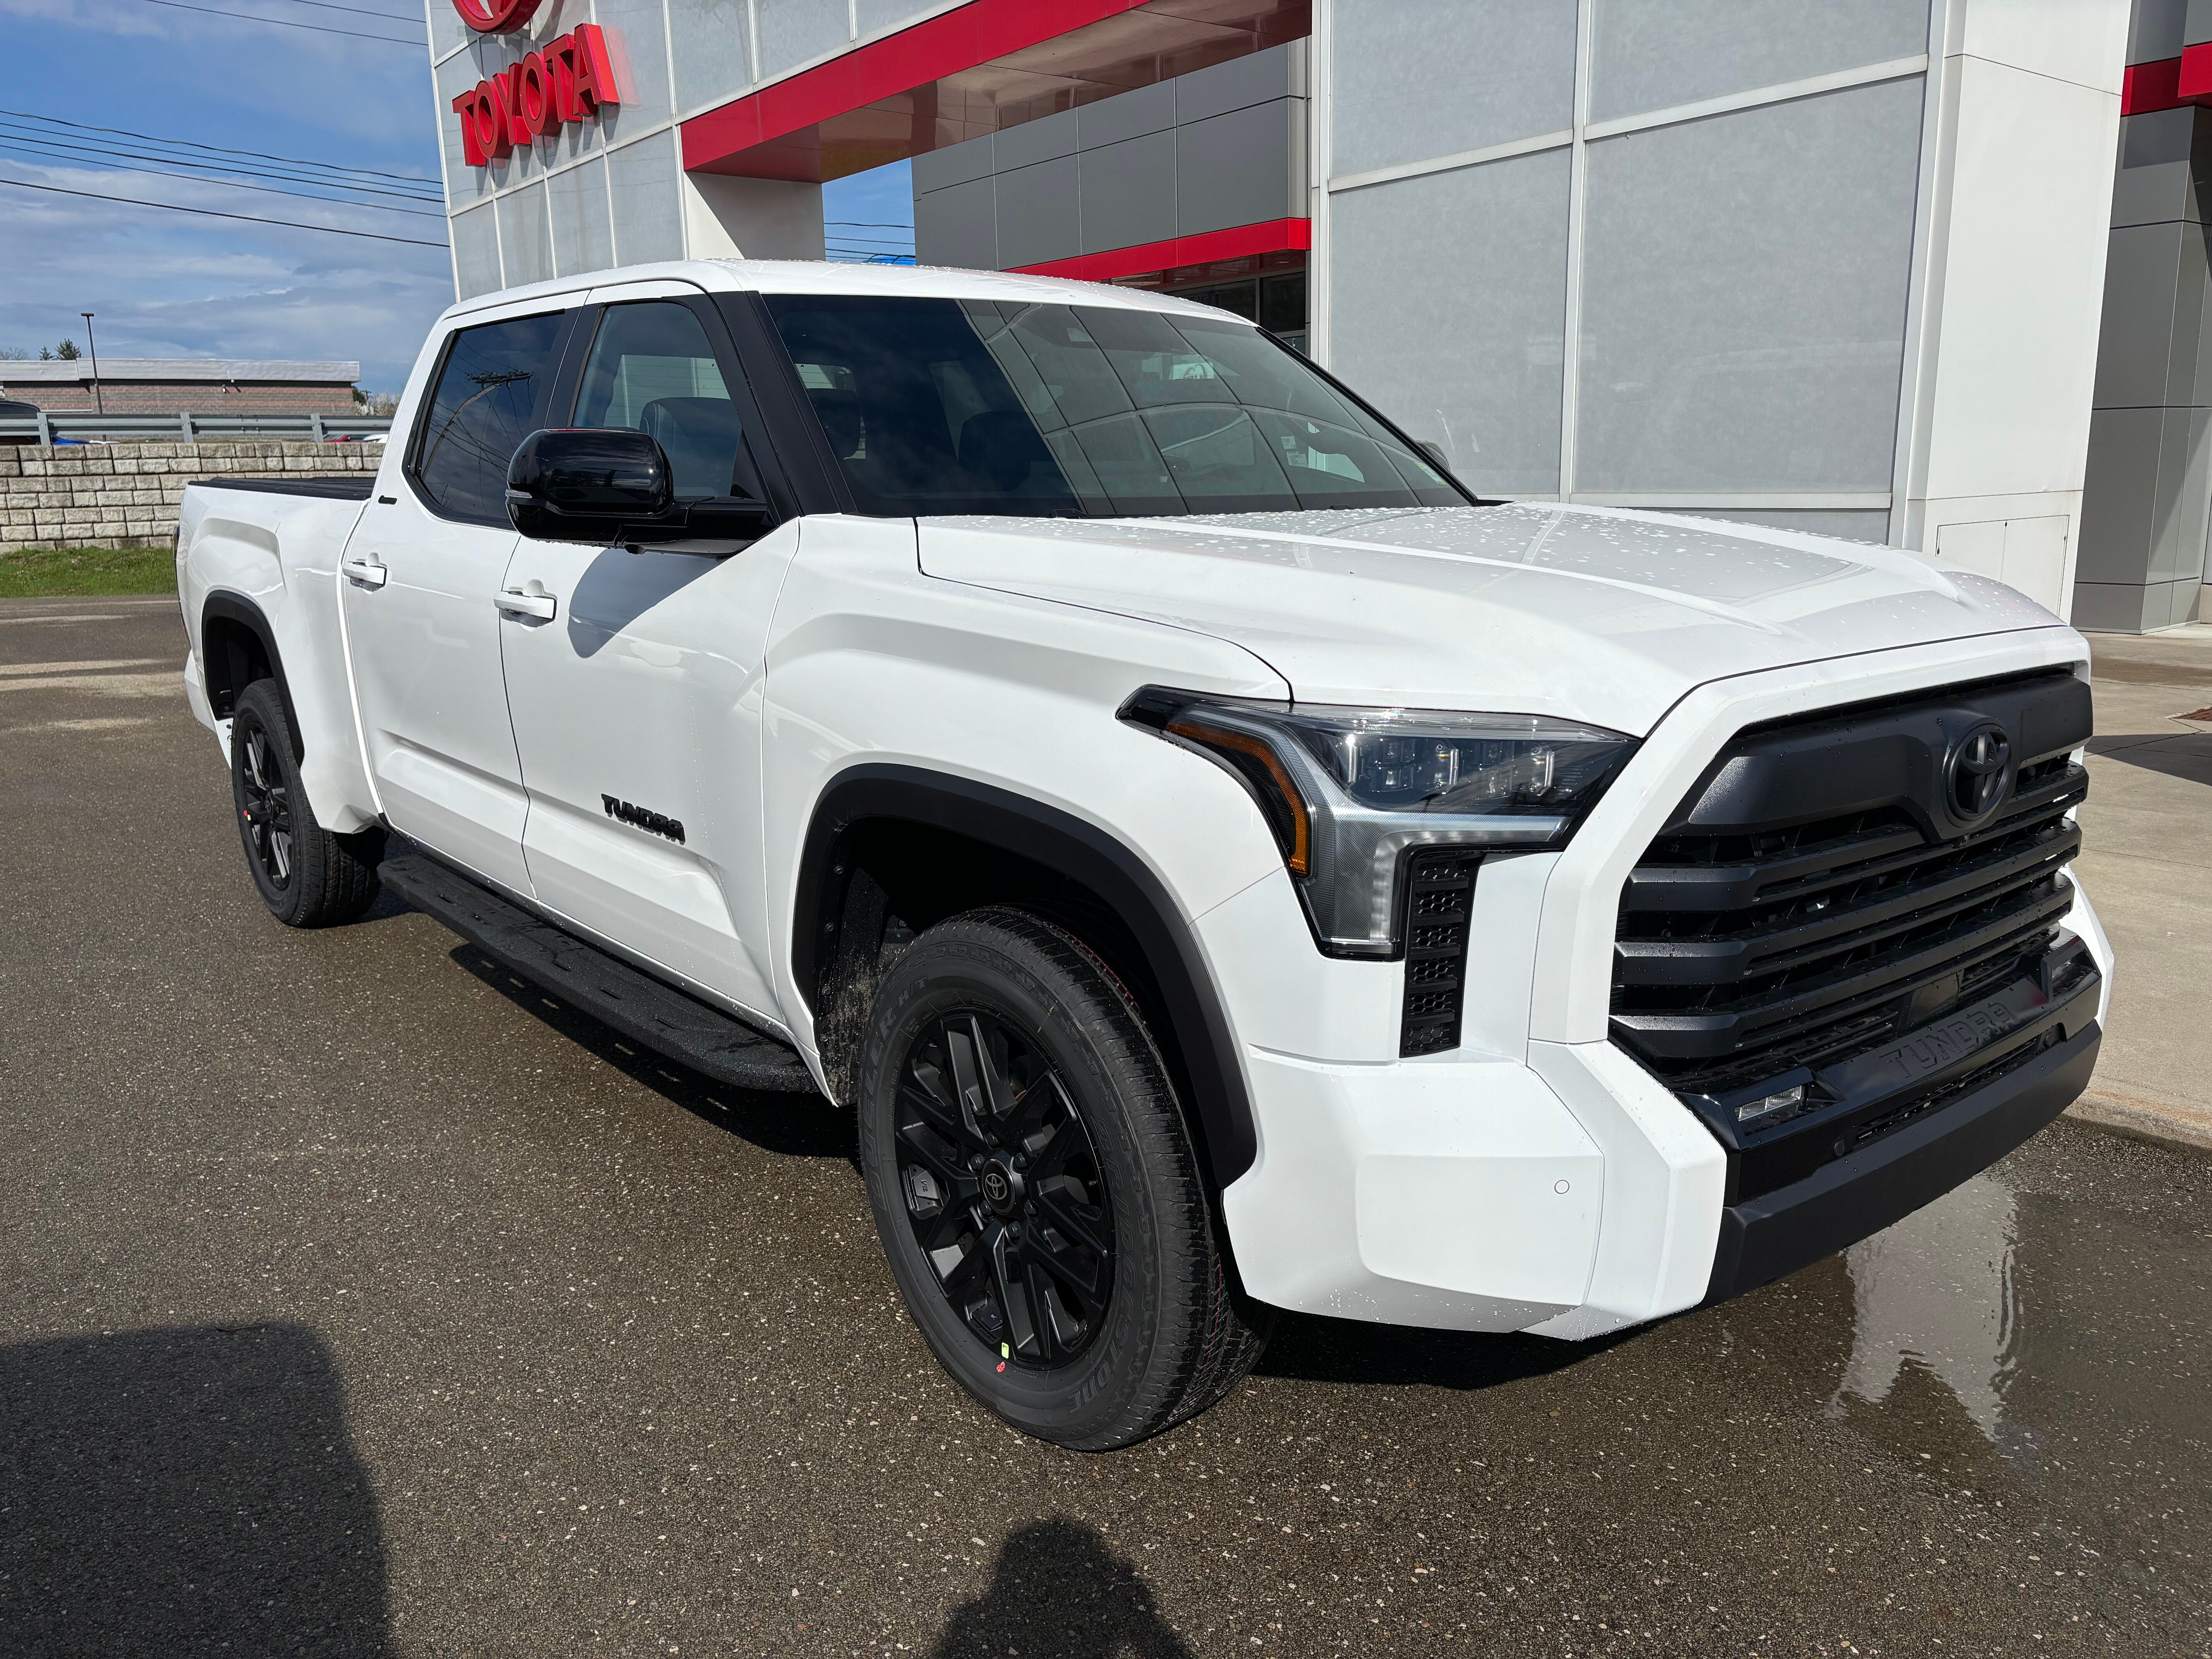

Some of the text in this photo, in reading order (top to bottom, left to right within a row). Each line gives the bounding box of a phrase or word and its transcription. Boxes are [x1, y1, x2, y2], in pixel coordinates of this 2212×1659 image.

[452, 23, 620, 166] TOYOTA
[601, 793, 685, 844] TUNDRA
[863, 1006, 896, 1211] DUELER
[1878, 1002, 2019, 1078] TUNDRA
[1068, 1117, 1136, 1415] BRIDGESTONE
